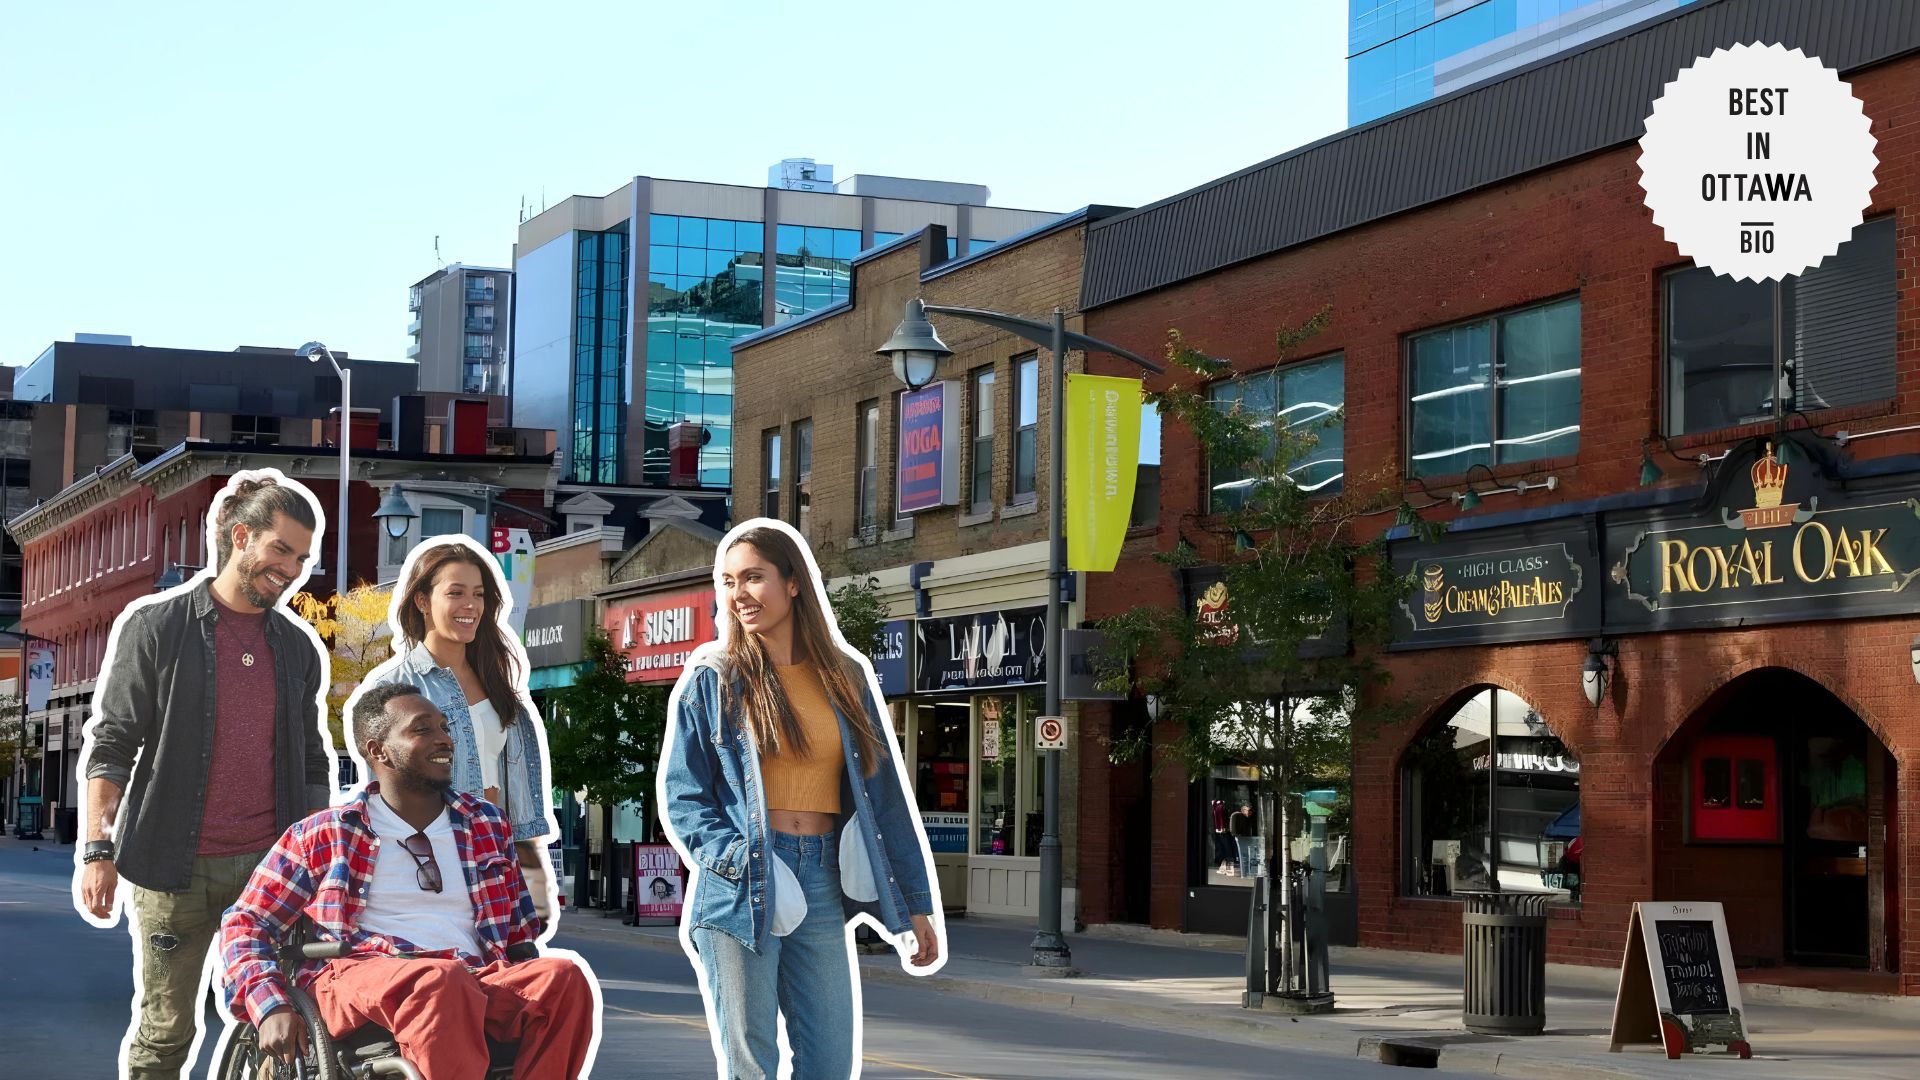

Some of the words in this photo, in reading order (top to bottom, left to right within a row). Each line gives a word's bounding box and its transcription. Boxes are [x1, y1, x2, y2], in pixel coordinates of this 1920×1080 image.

[904, 424, 941, 458] YOGA
[1463, 562, 1494, 578] HIGH
[1658, 537, 1784, 594] ROYAL
[1792, 521, 1895, 583] OAK
[1445, 585, 1487, 614] CREAM
[644, 606, 693, 646] SUSHI
